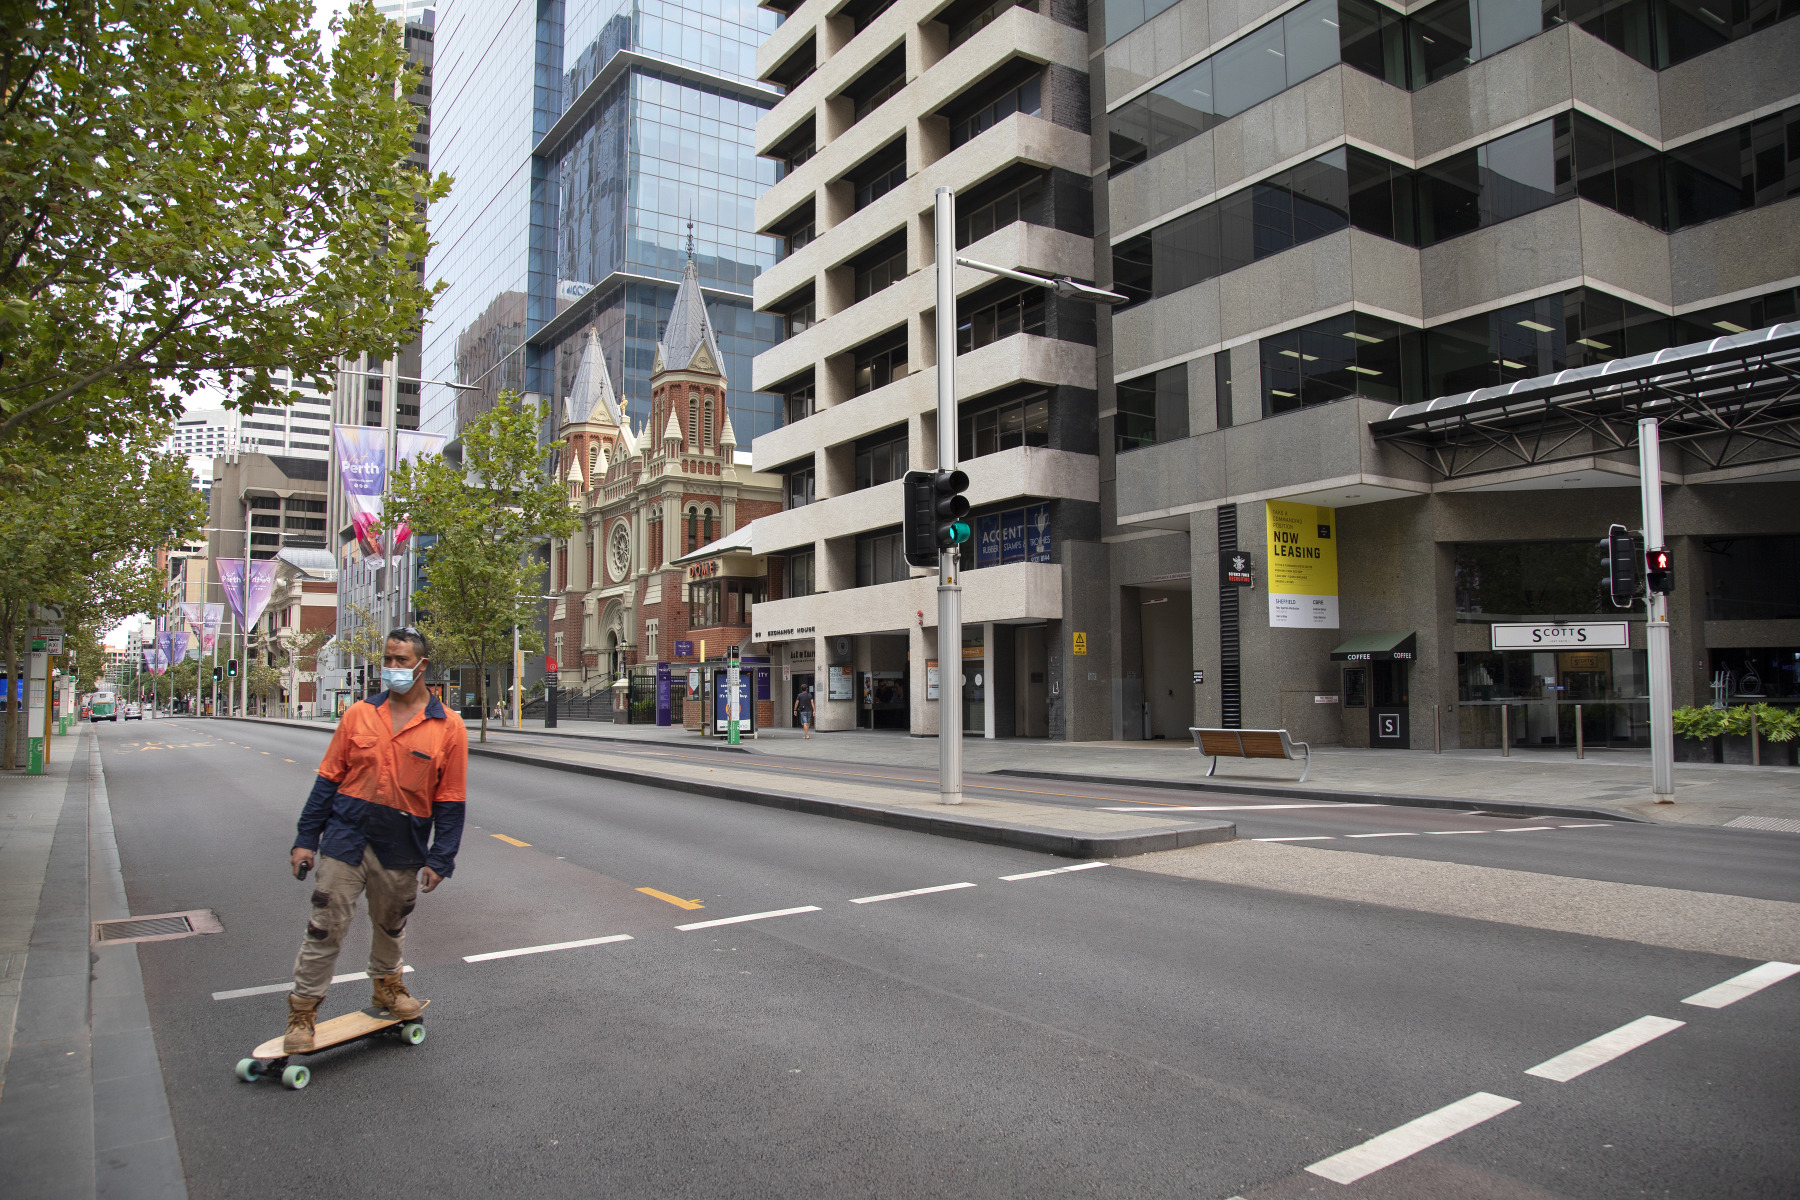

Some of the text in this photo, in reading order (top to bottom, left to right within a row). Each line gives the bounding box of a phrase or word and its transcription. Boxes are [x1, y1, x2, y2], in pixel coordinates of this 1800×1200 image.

[342, 460, 380, 475] Perth
[1272, 516, 1302, 525] COMMANDING
[982, 525, 1023, 544] ACCENT
[1273, 531, 1299, 544] NOW
[982, 544, 999, 555] RUBBER
[1003, 541, 1022, 552] STAMPS
[1274, 545, 1321, 559] LEASING
[221, 574, 242, 583] Perth
[767, 628, 794, 637] EXCHANGE
[796, 626, 816, 634] HOUSE
[1532, 628, 1587, 643] SCOTTS
[1385, 719, 1394, 732] S
